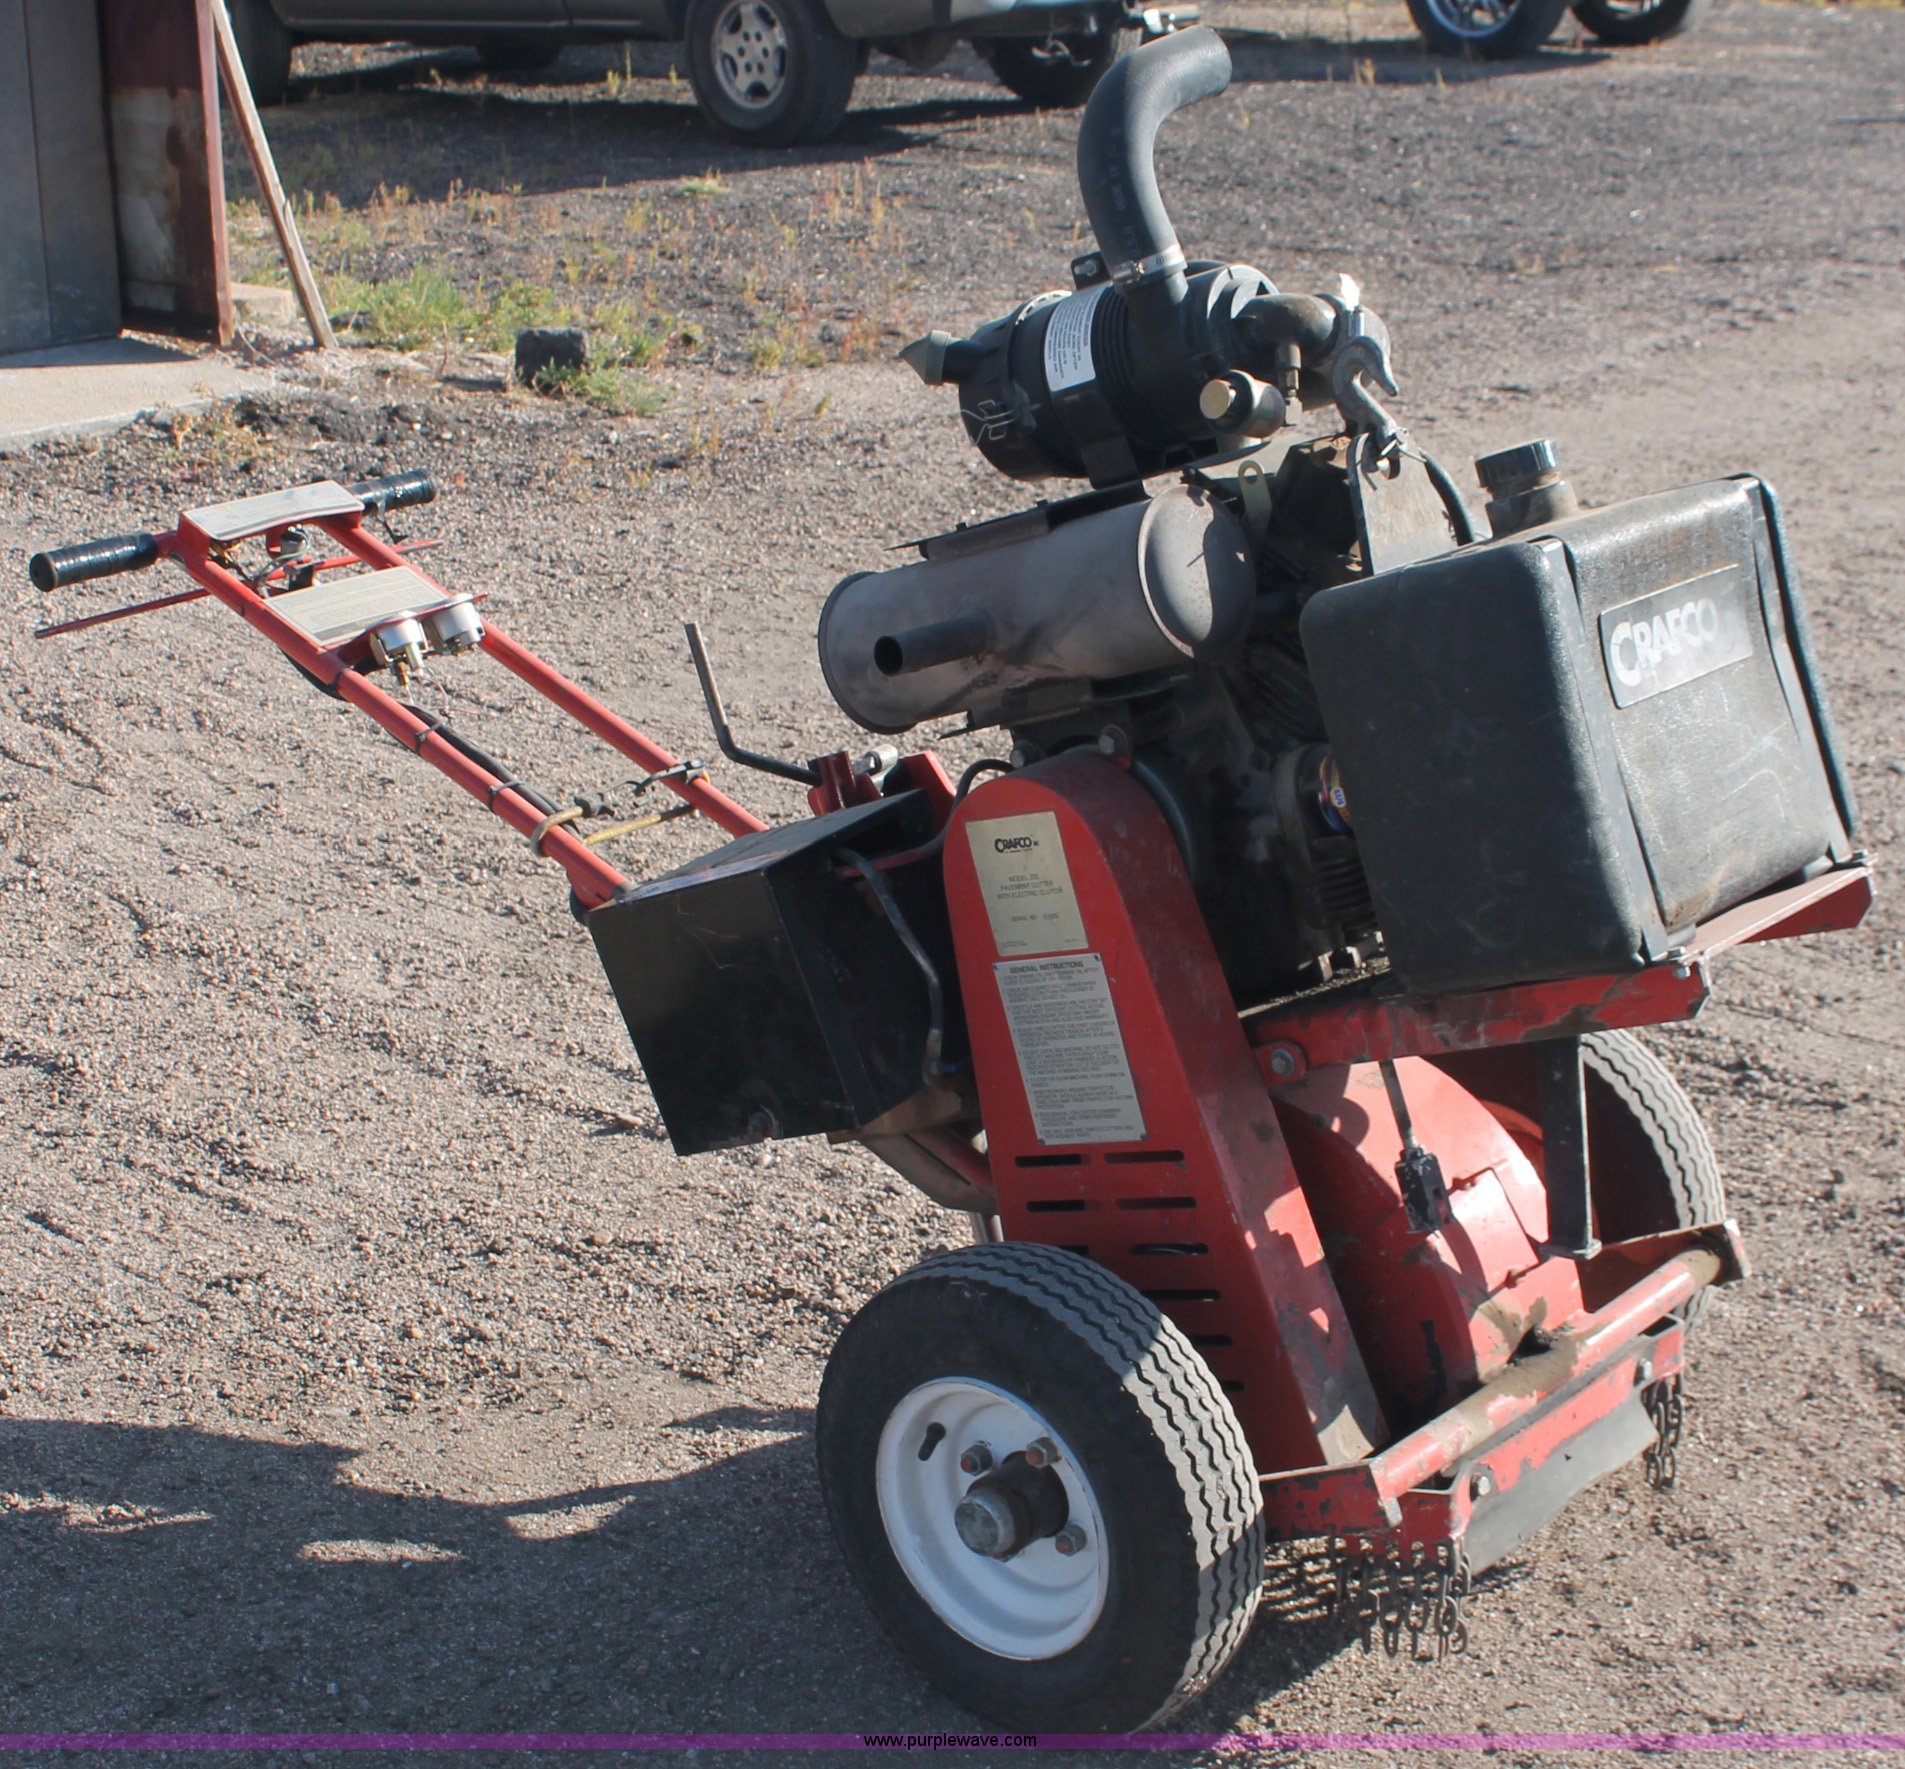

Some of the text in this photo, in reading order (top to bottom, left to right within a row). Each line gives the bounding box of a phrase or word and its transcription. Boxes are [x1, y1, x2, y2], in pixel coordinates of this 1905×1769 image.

[1610, 597, 1719, 687] CRAFCO
[994, 836, 1032, 853] CRAFCO
[1008, 874, 1029, 883] MODEL
[1000, 880, 1054, 891] PAVEMENT CUTTER
[1011, 890, 1038, 899] ELECTRIC
[1039, 886, 1063, 896] CLUTCH
[1009, 961, 1084, 974] GENERAL INSTRUCTIONS
